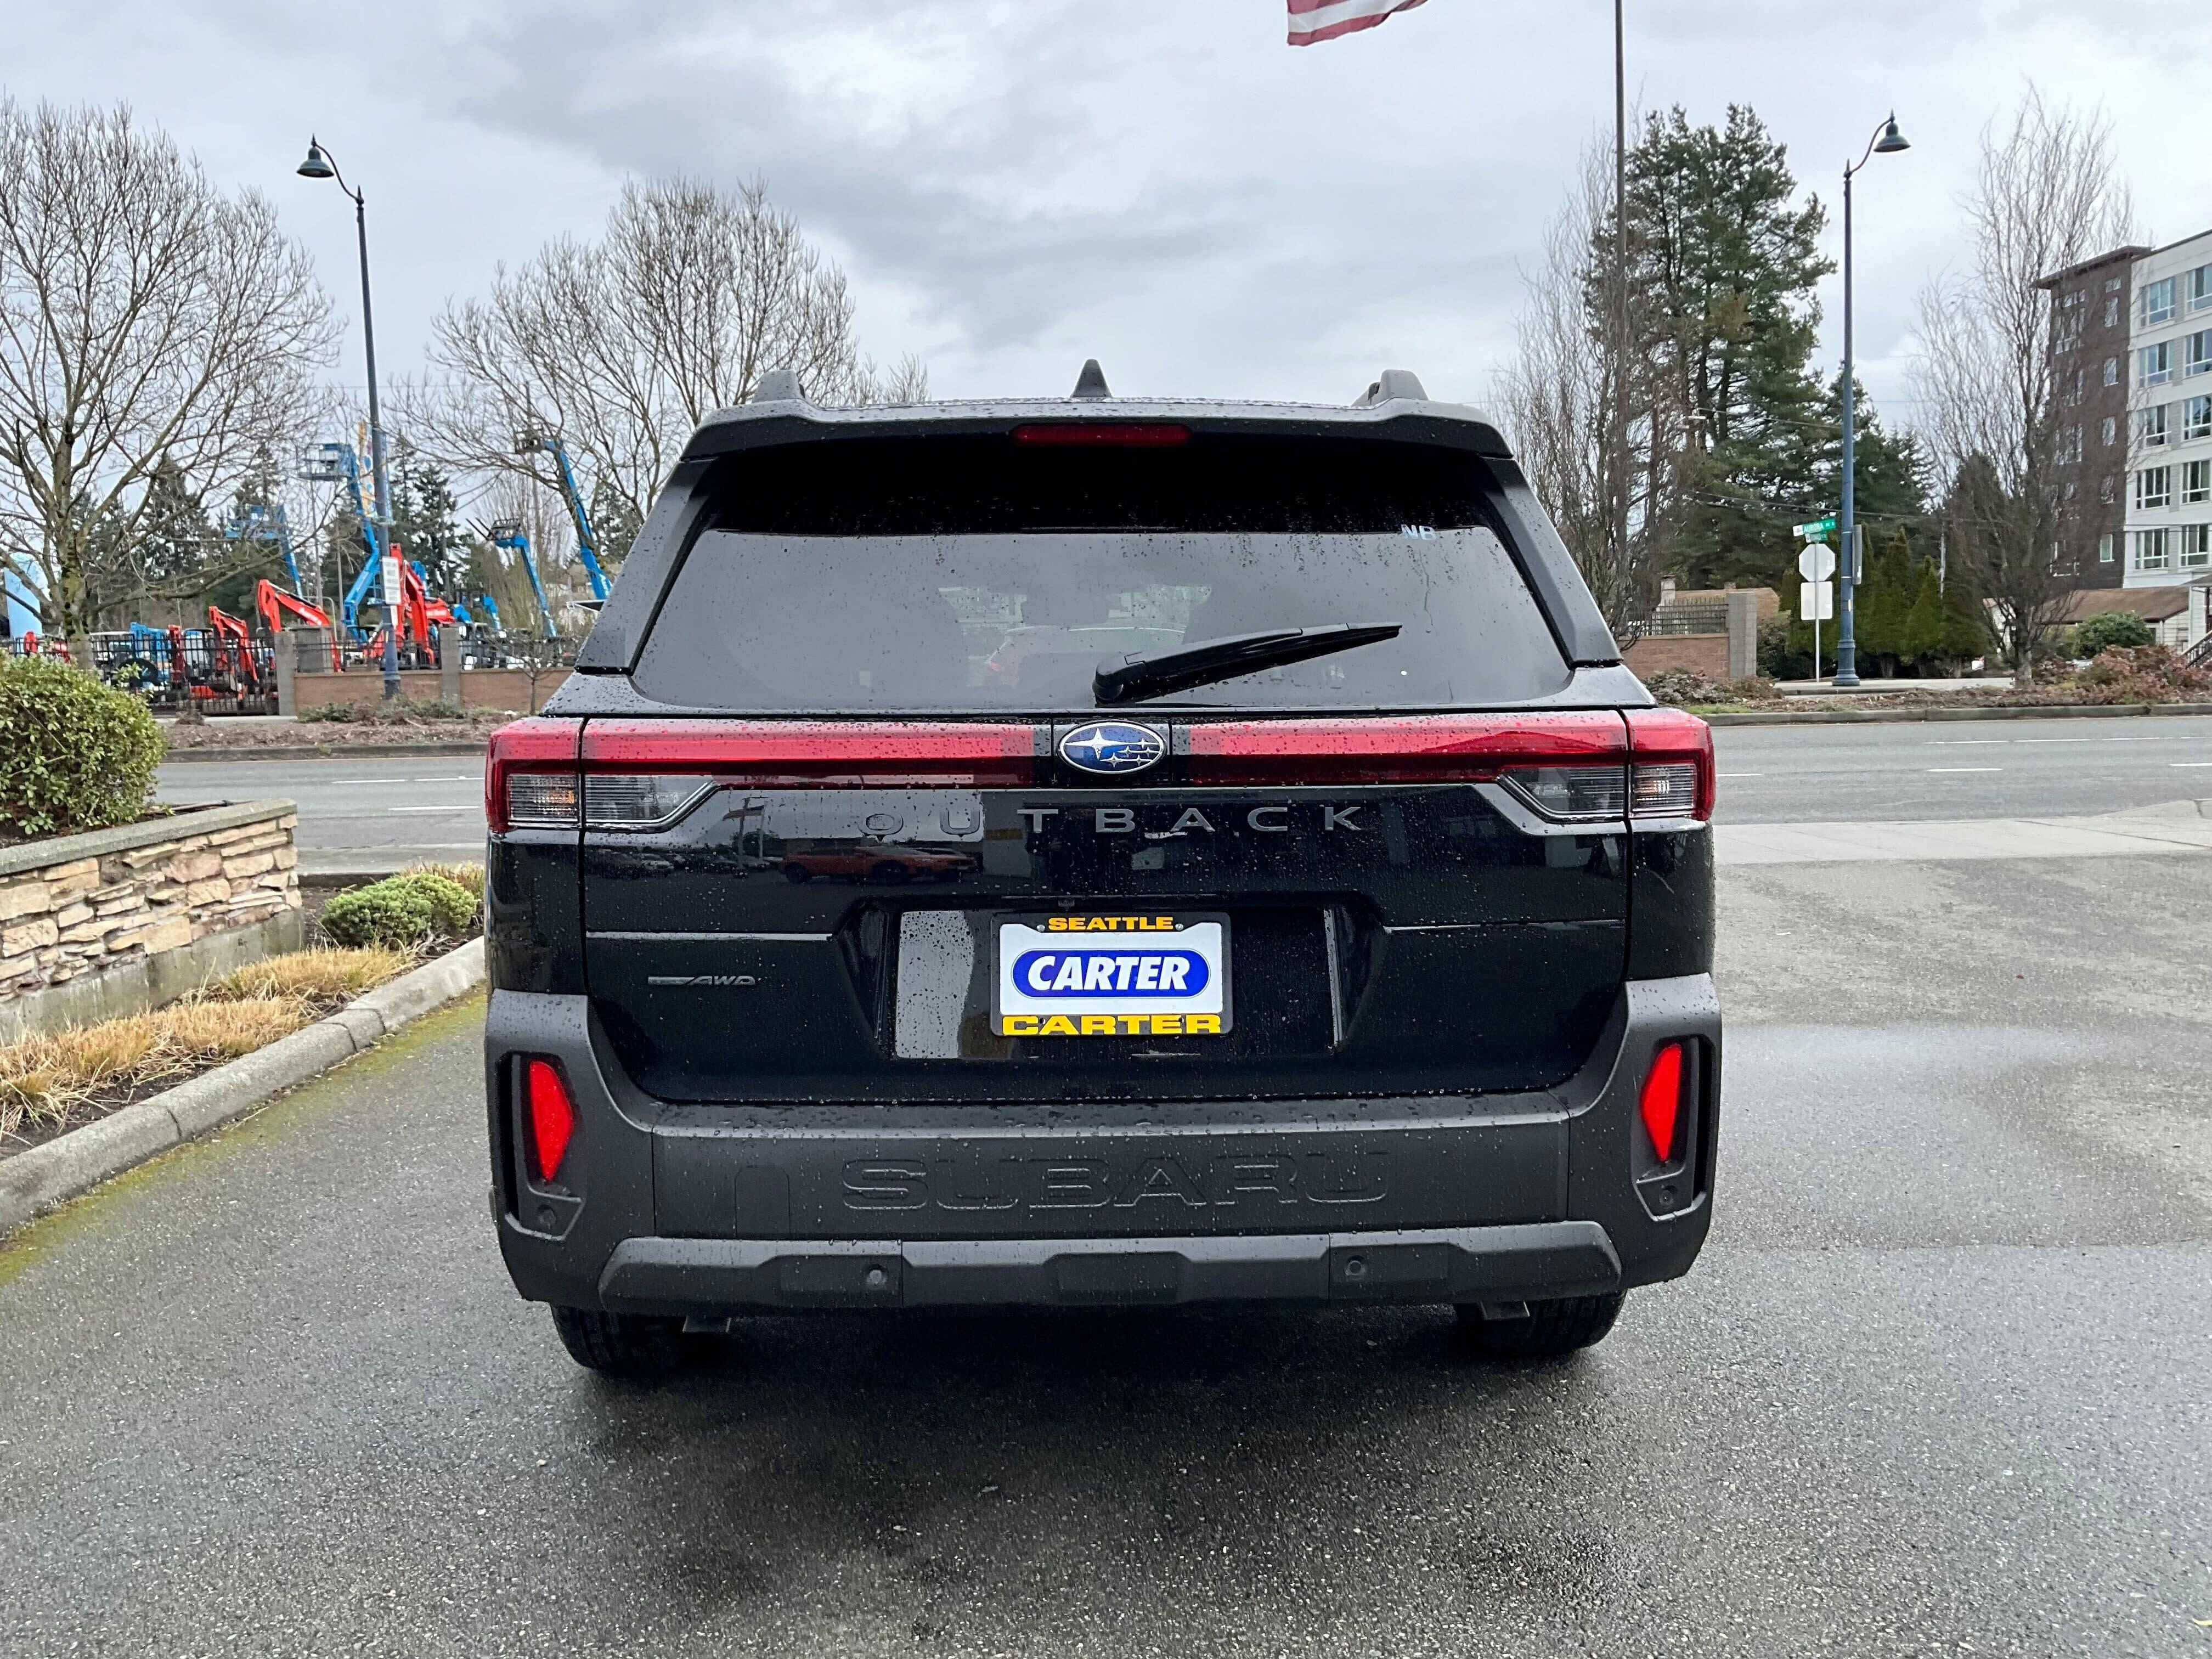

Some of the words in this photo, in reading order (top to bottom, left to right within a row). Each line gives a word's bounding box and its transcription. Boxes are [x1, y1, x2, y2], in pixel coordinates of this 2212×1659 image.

[1401, 524, 1437, 540] NB
[1804, 522, 1824, 533] AURORA
[857, 806, 1362, 836] OUTBACK
[1048, 917, 1173, 931] SEATTLE
[688, 975, 755, 986] AWD
[1028, 955, 1190, 991] CARTER
[1002, 1014, 1221, 1035] CARTER
[842, 1152, 1390, 1210] SUBARU
